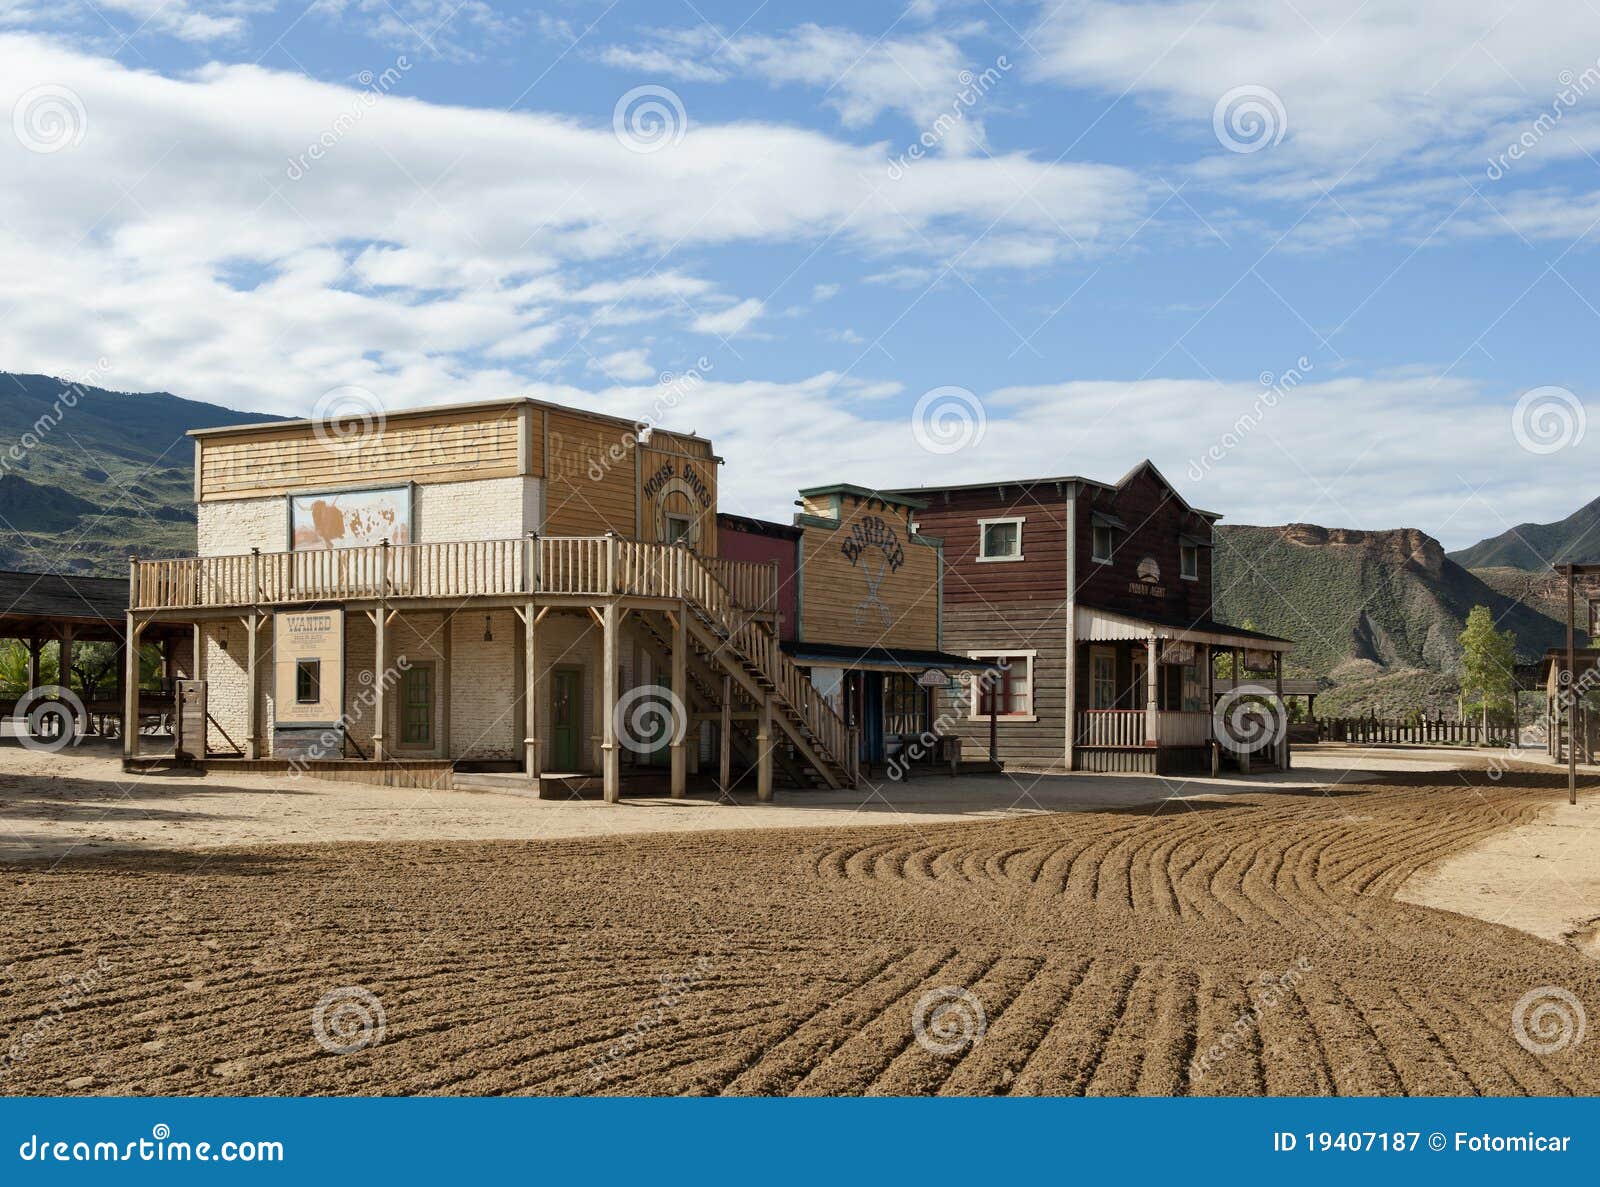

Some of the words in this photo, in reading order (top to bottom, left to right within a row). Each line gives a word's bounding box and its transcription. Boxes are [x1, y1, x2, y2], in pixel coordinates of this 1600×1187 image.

[643, 459, 674, 500] HORSE
[683, 463, 712, 508] SHOES
[841, 516, 905, 574] BARBER
[287, 615, 331, 632] WANTED
